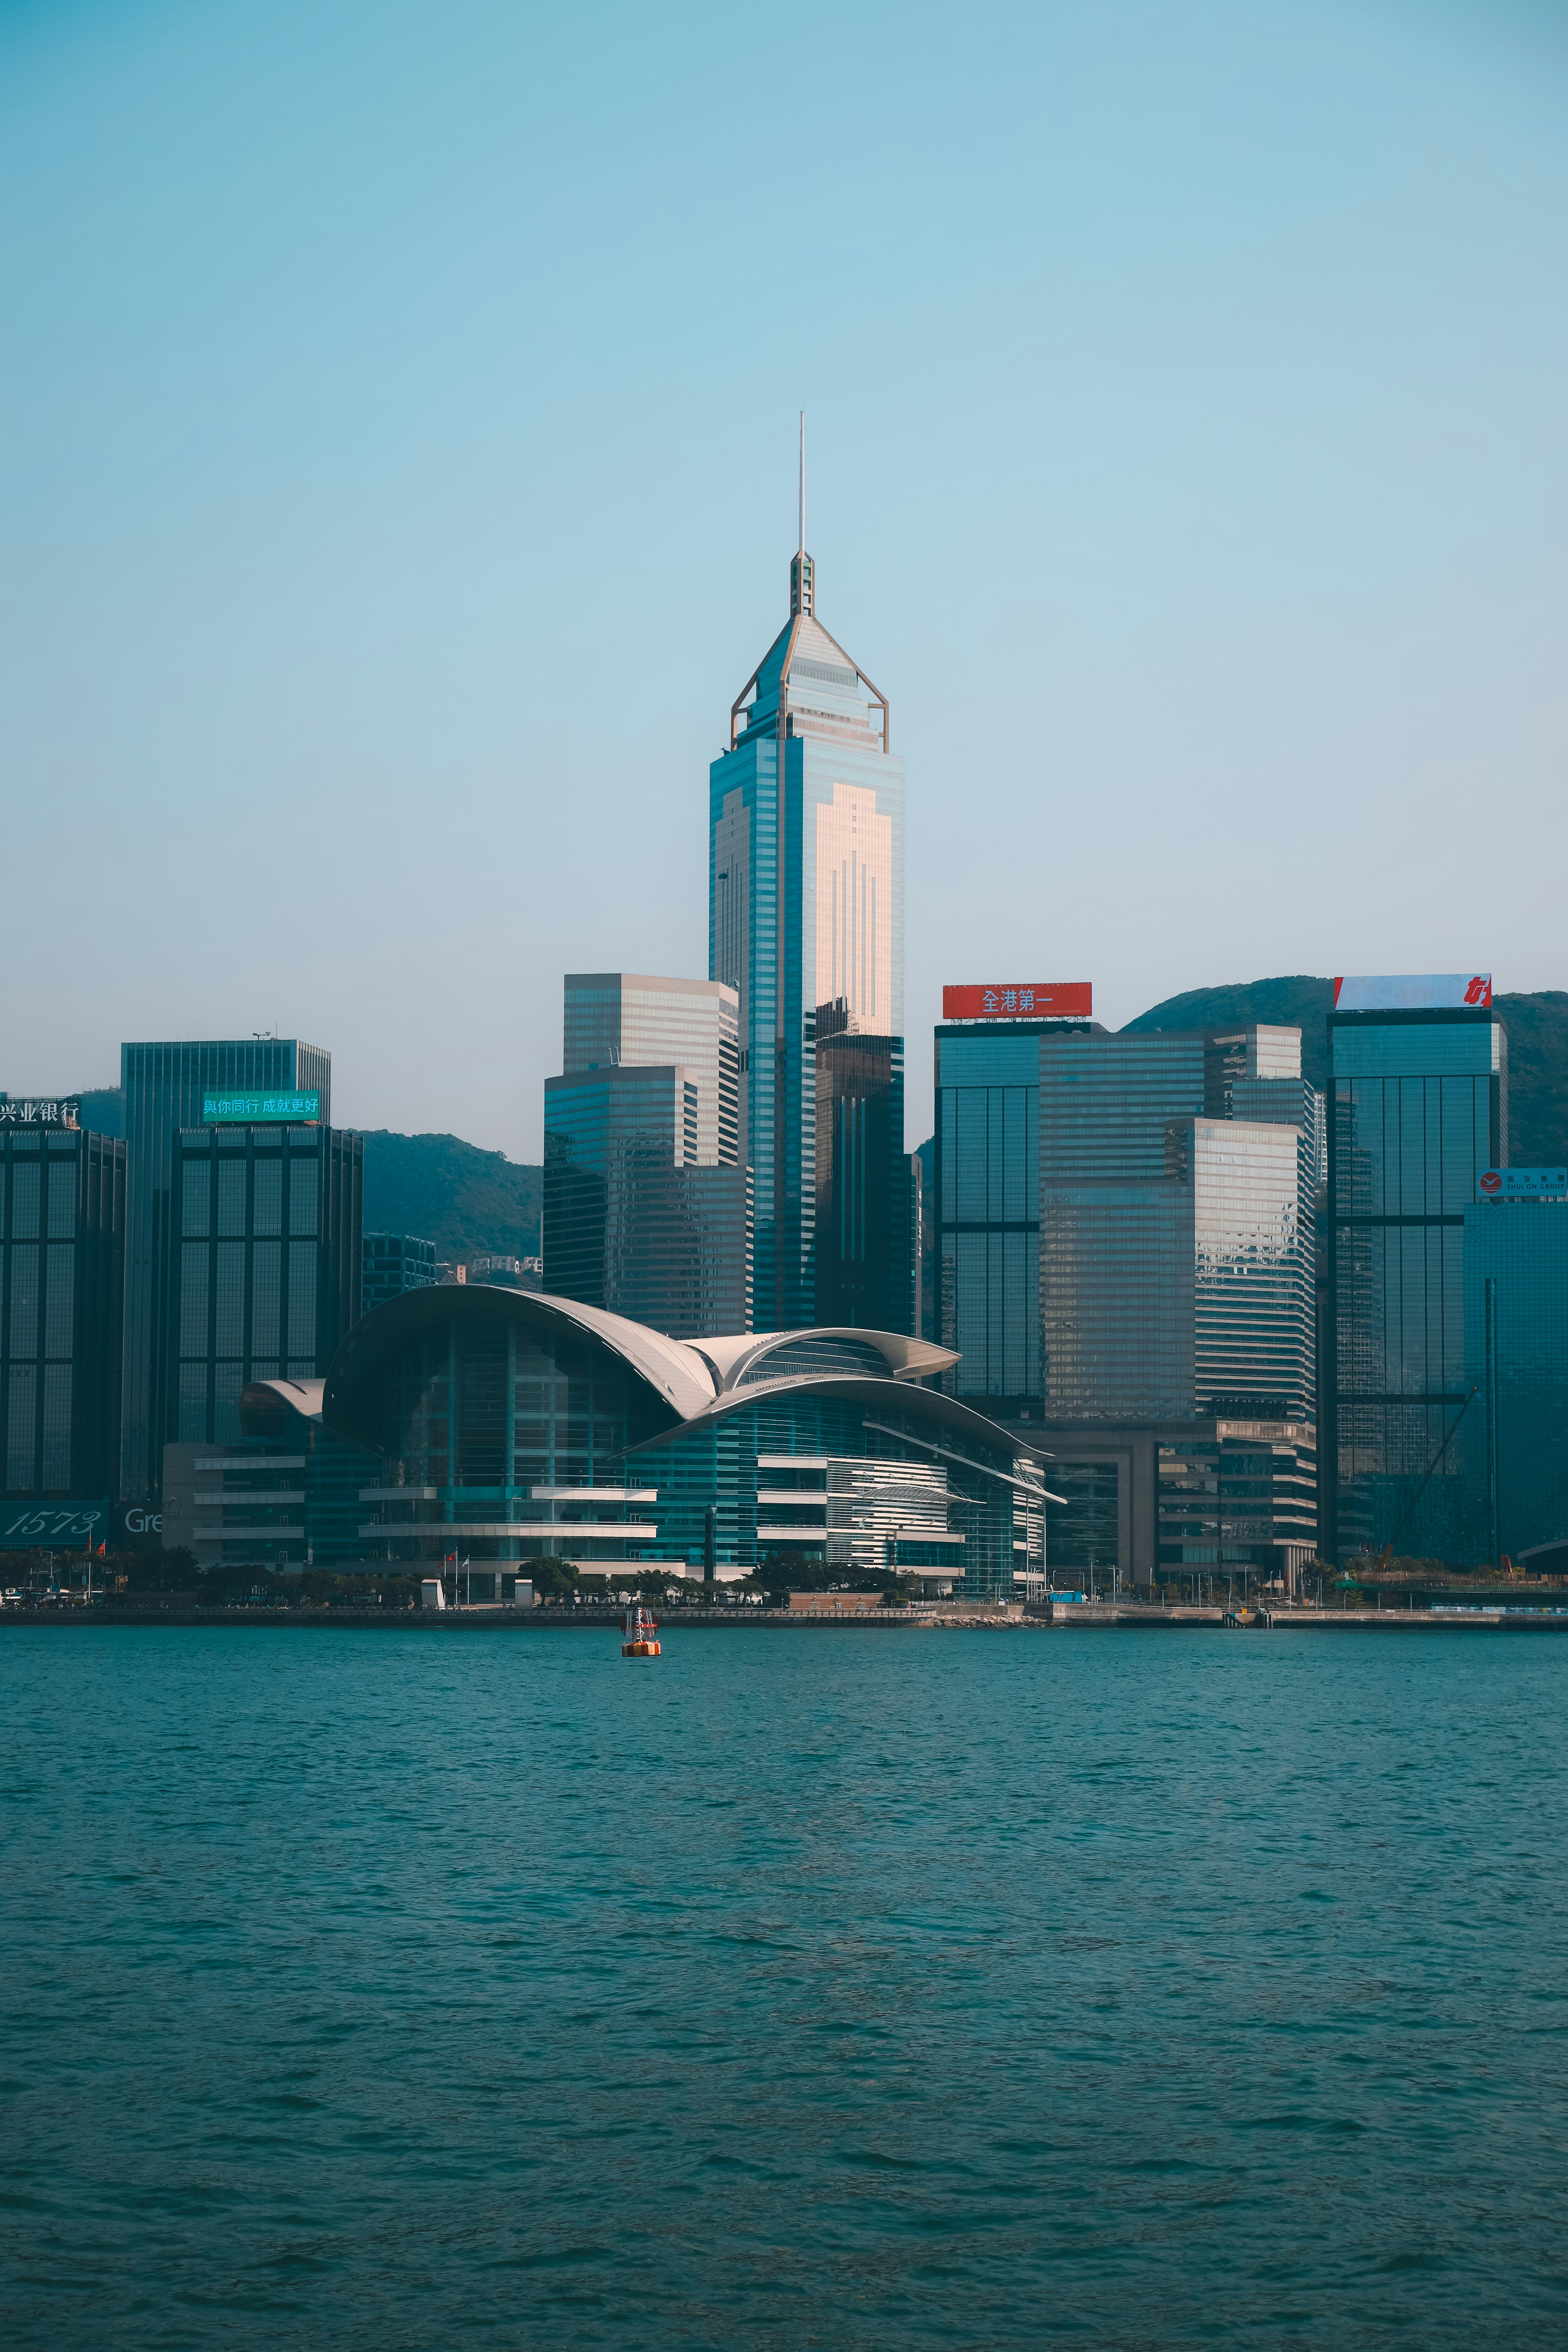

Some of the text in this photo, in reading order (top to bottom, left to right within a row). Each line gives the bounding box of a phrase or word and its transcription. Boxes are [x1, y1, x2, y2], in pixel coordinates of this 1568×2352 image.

[983, 989, 1053, 1012] 全港第一
[0, 1102, 79, 1122] 兴业银行
[203, 1098, 319, 1114] 與你同行 成就更好
[4, 1511, 101, 1535] 1573
[125, 1508, 162, 1533] Gre
